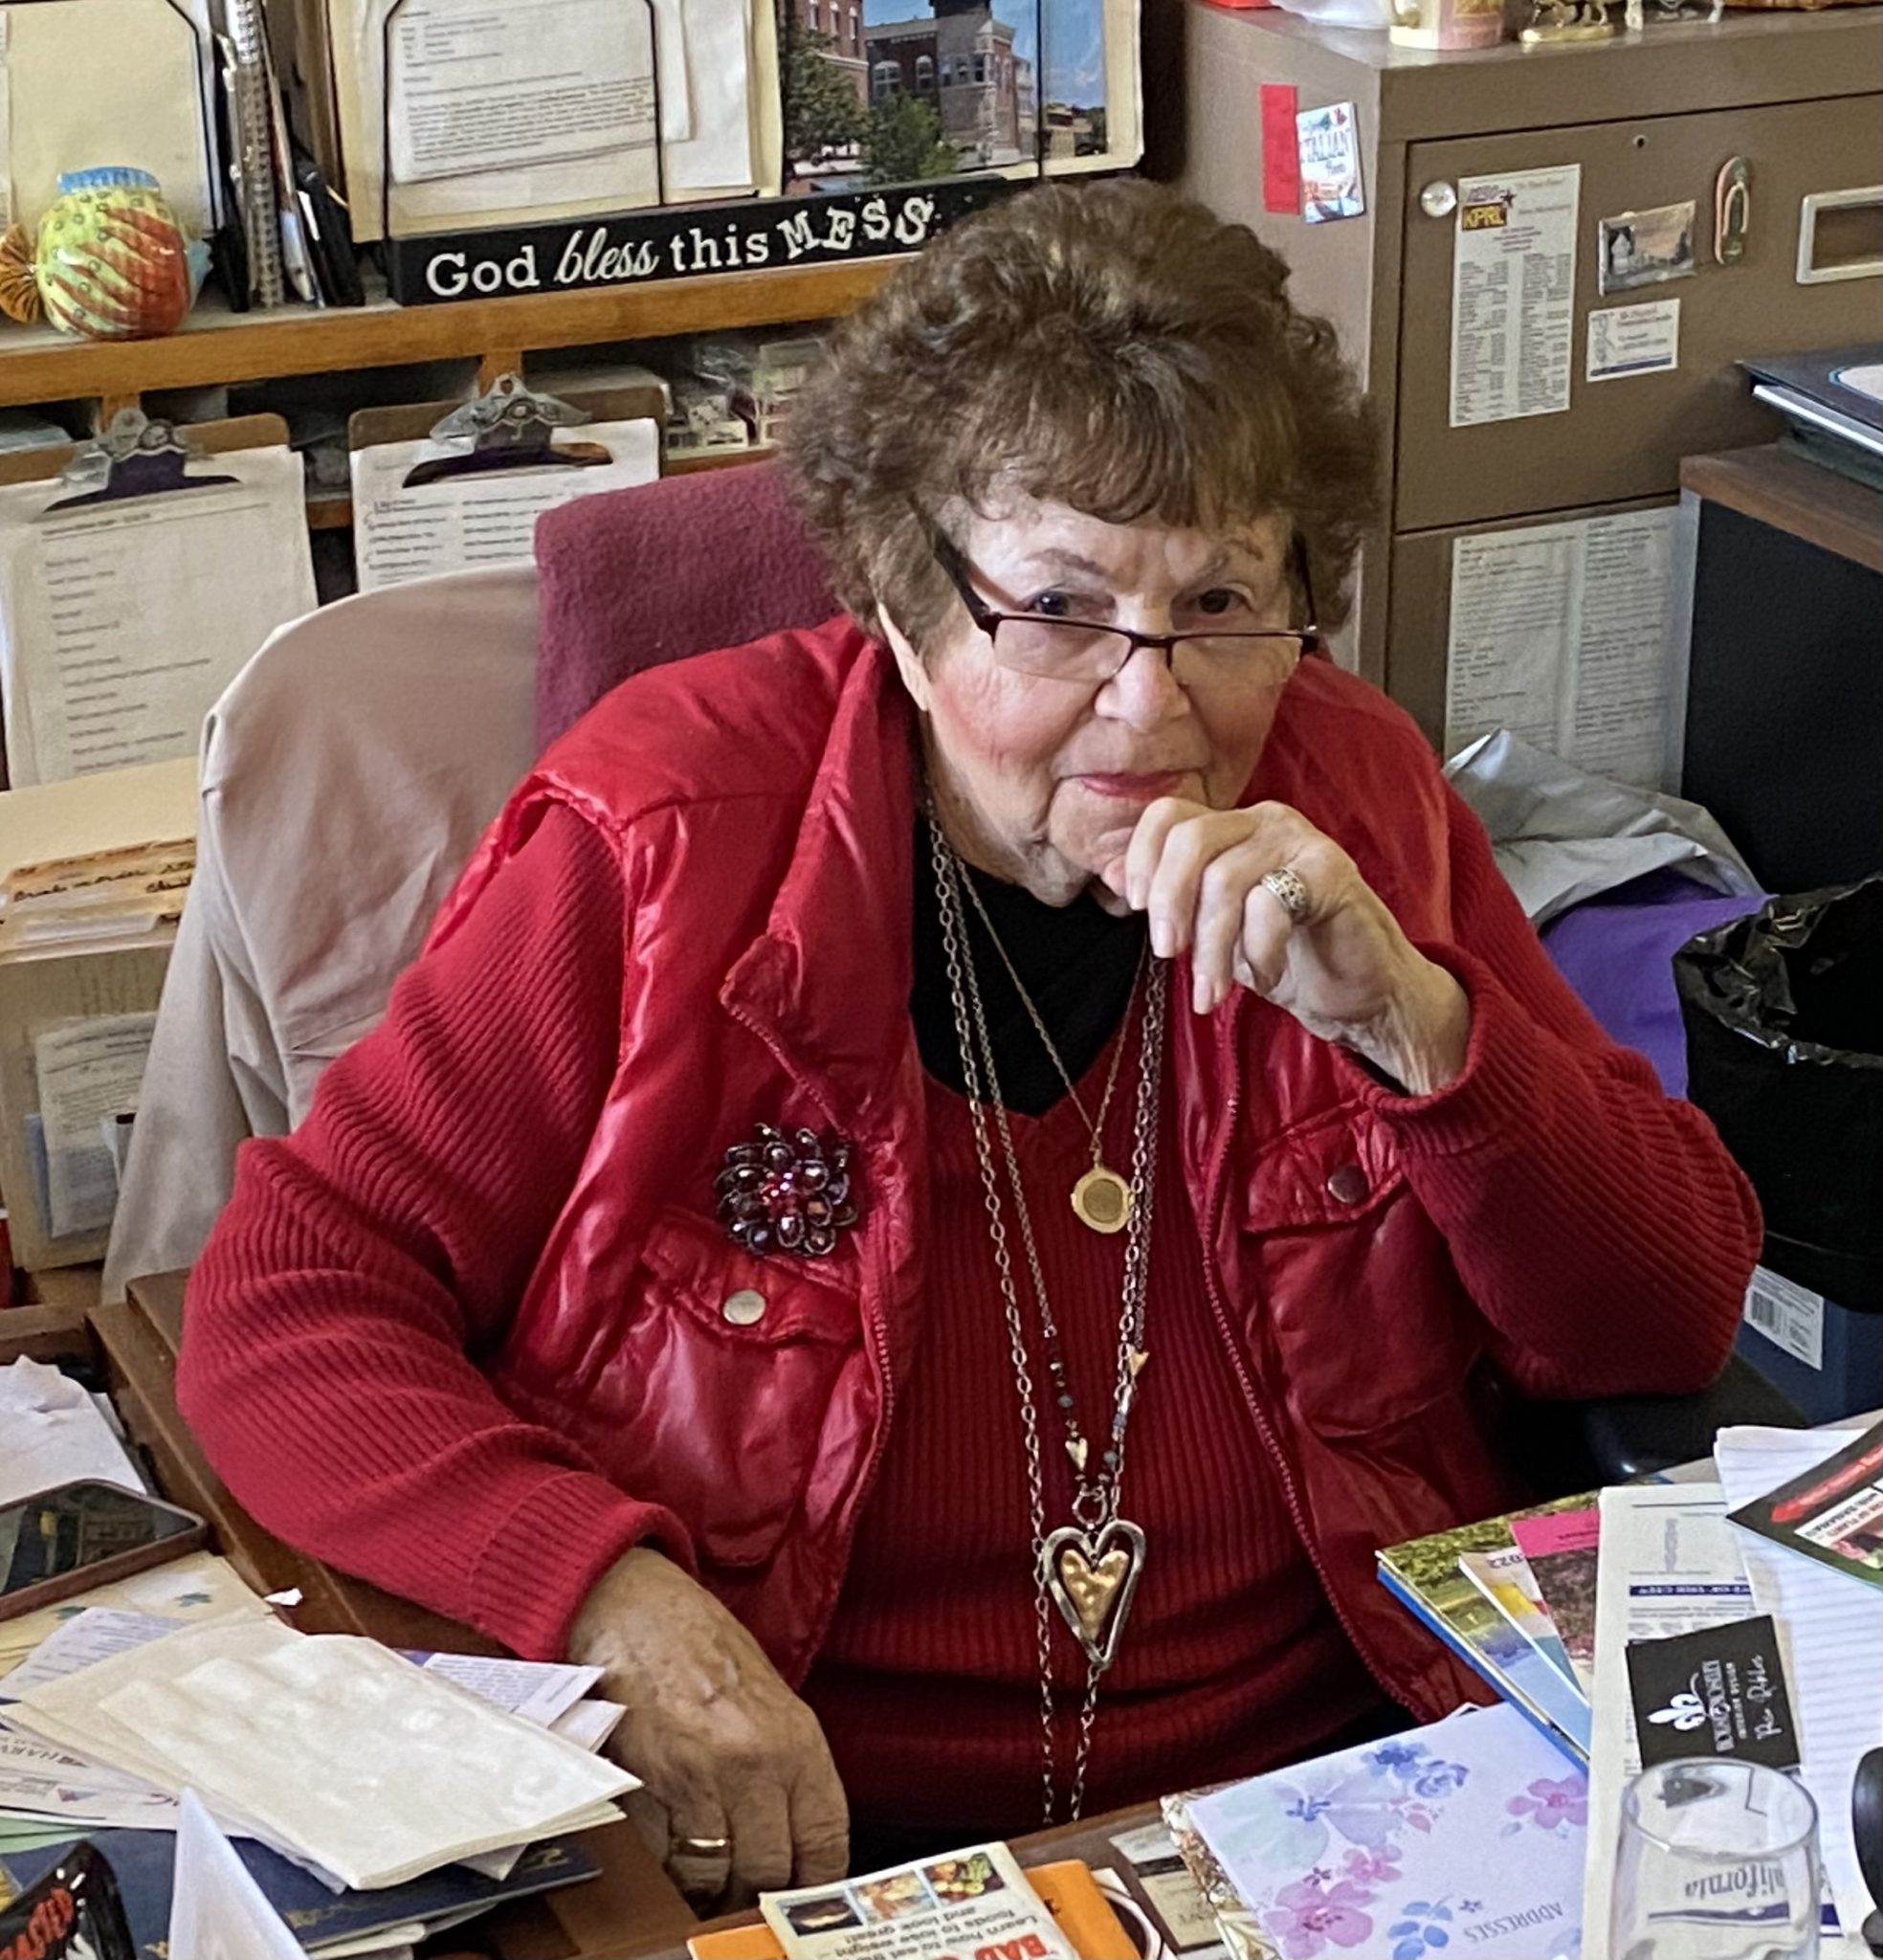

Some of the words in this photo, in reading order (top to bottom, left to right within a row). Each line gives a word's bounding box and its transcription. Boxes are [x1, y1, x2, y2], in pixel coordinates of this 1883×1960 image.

[1465, 205, 1505, 229] KPRL
[427, 246, 539, 296] God
[554, 228, 661, 282] bless
[671, 224, 769, 272] this
[777, 195, 934, 258] MESS
[1487, 1553, 1525, 1569] 022
[1685, 1864, 1785, 1900] alifornia
[900, 1916, 940, 1930] look
[942, 1906, 977, 1922] and
[964, 1909, 1015, 1927] foods
[1463, 1902, 1563, 1943] ADDRESSES
[942, 1924, 961, 1934] to
[986, 1915, 1038, 1934] Learn
[845, 1925, 896, 1945] great!
[900, 1929, 937, 1943] lose
[945, 1932, 984, 1948] how
[835, 1939, 894, 1957] weight
[921, 1941, 942, 1951] to
[974, 1933, 1049, 1960] BAD
